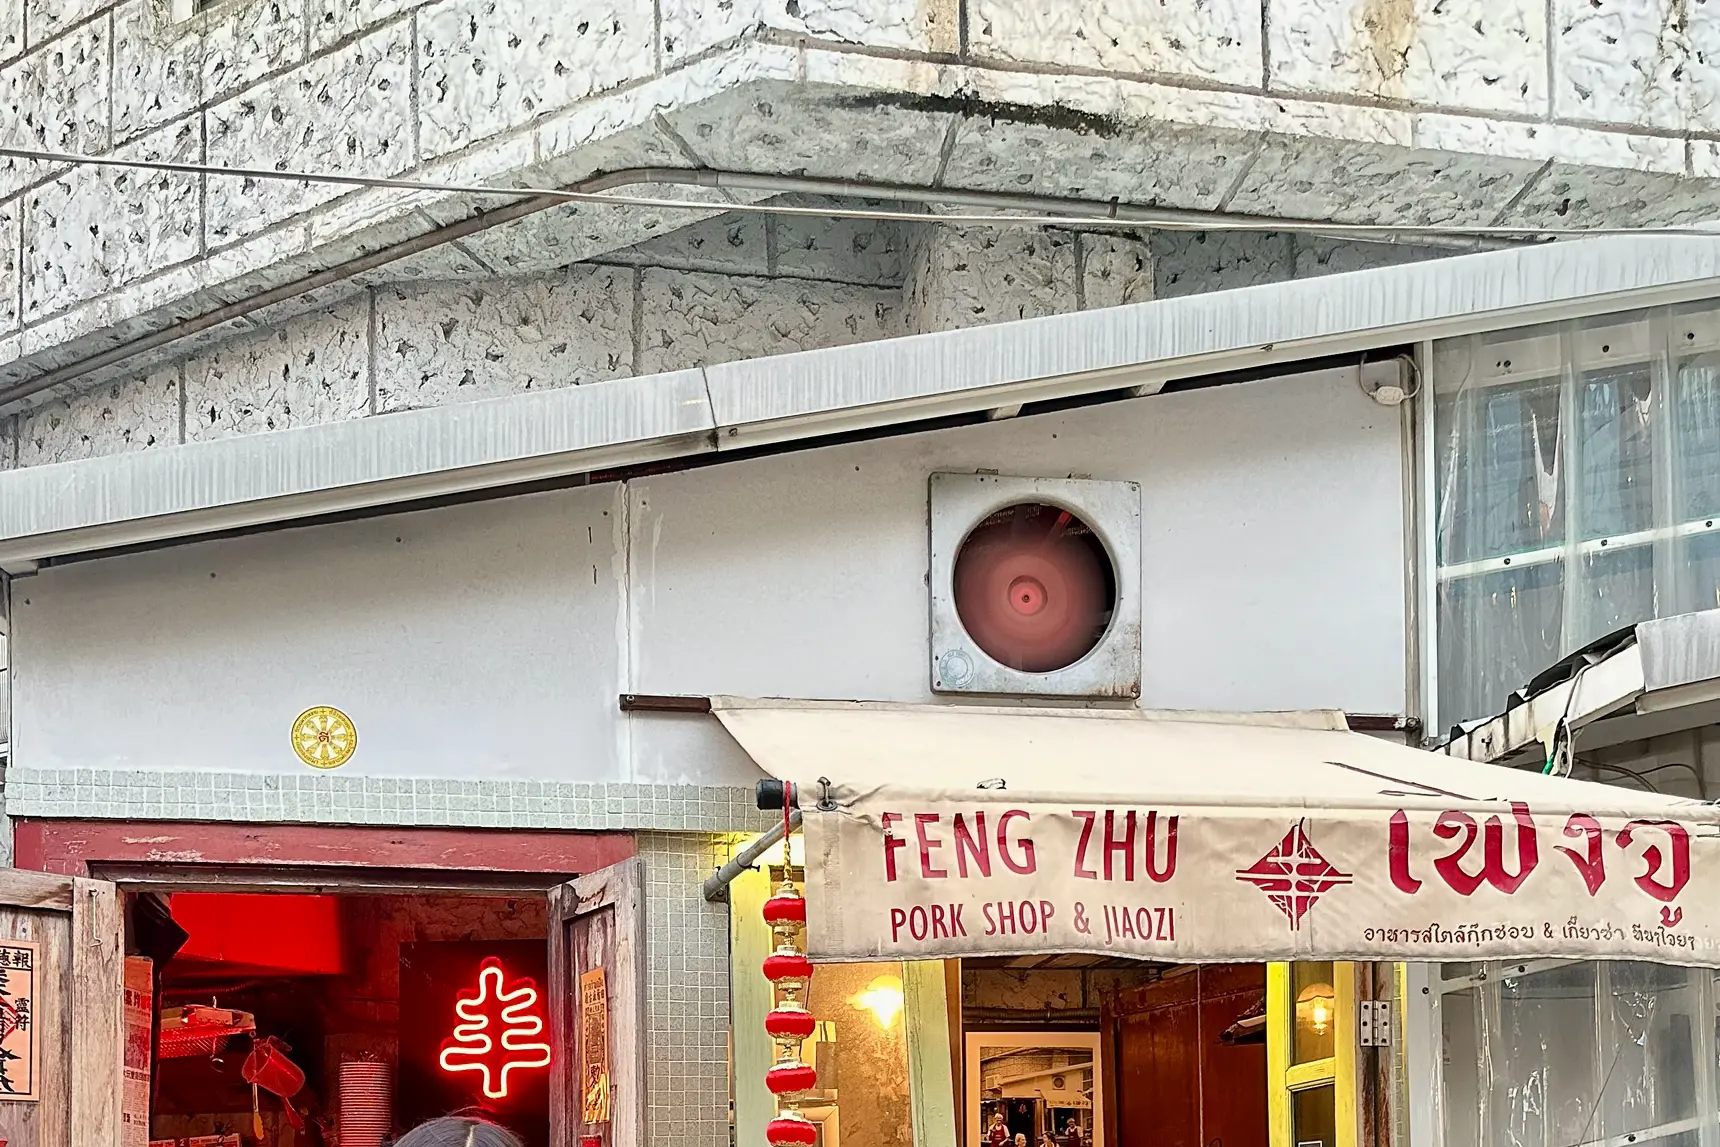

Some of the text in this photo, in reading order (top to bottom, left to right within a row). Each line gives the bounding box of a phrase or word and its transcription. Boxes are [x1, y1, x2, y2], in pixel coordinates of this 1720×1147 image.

[880, 809, 1181, 883] FENG ZHU
[890, 899, 1177, 948] PORK SHOP & JIAOZI
[1543, 922, 1554, 939] &
